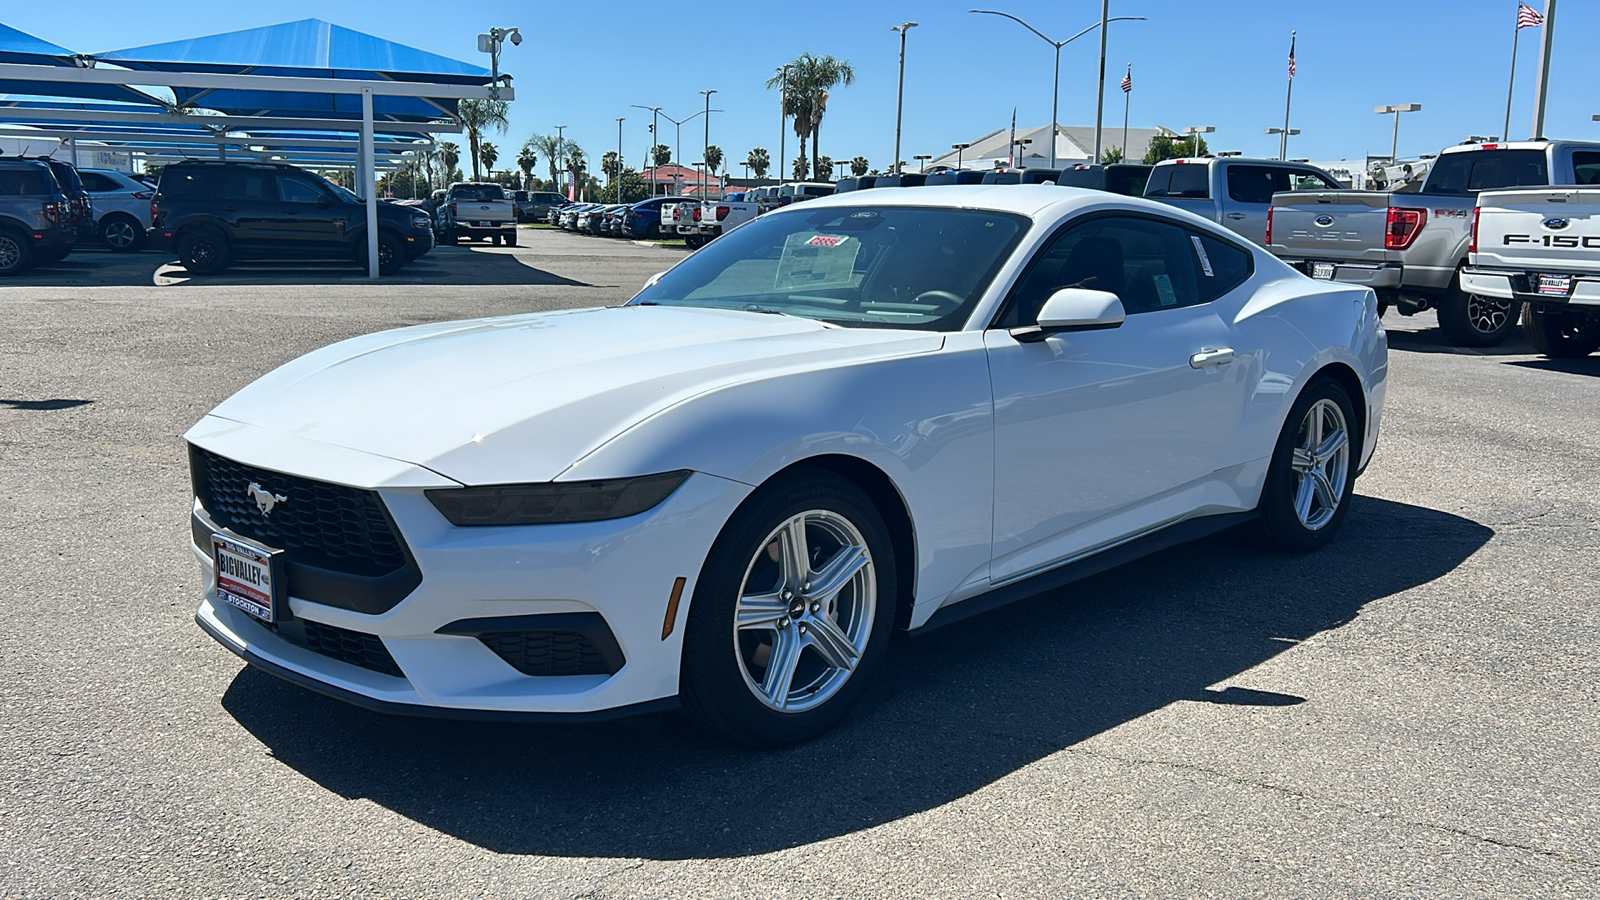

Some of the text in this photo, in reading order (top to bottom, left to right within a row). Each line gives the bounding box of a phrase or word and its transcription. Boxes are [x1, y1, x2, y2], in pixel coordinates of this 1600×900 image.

[1434, 209, 1467, 219] FX4
[1503, 234, 1600, 249] F-150
[220, 553, 261, 586] BIGVALLEY
[228, 594, 260, 615] STOCKTON
